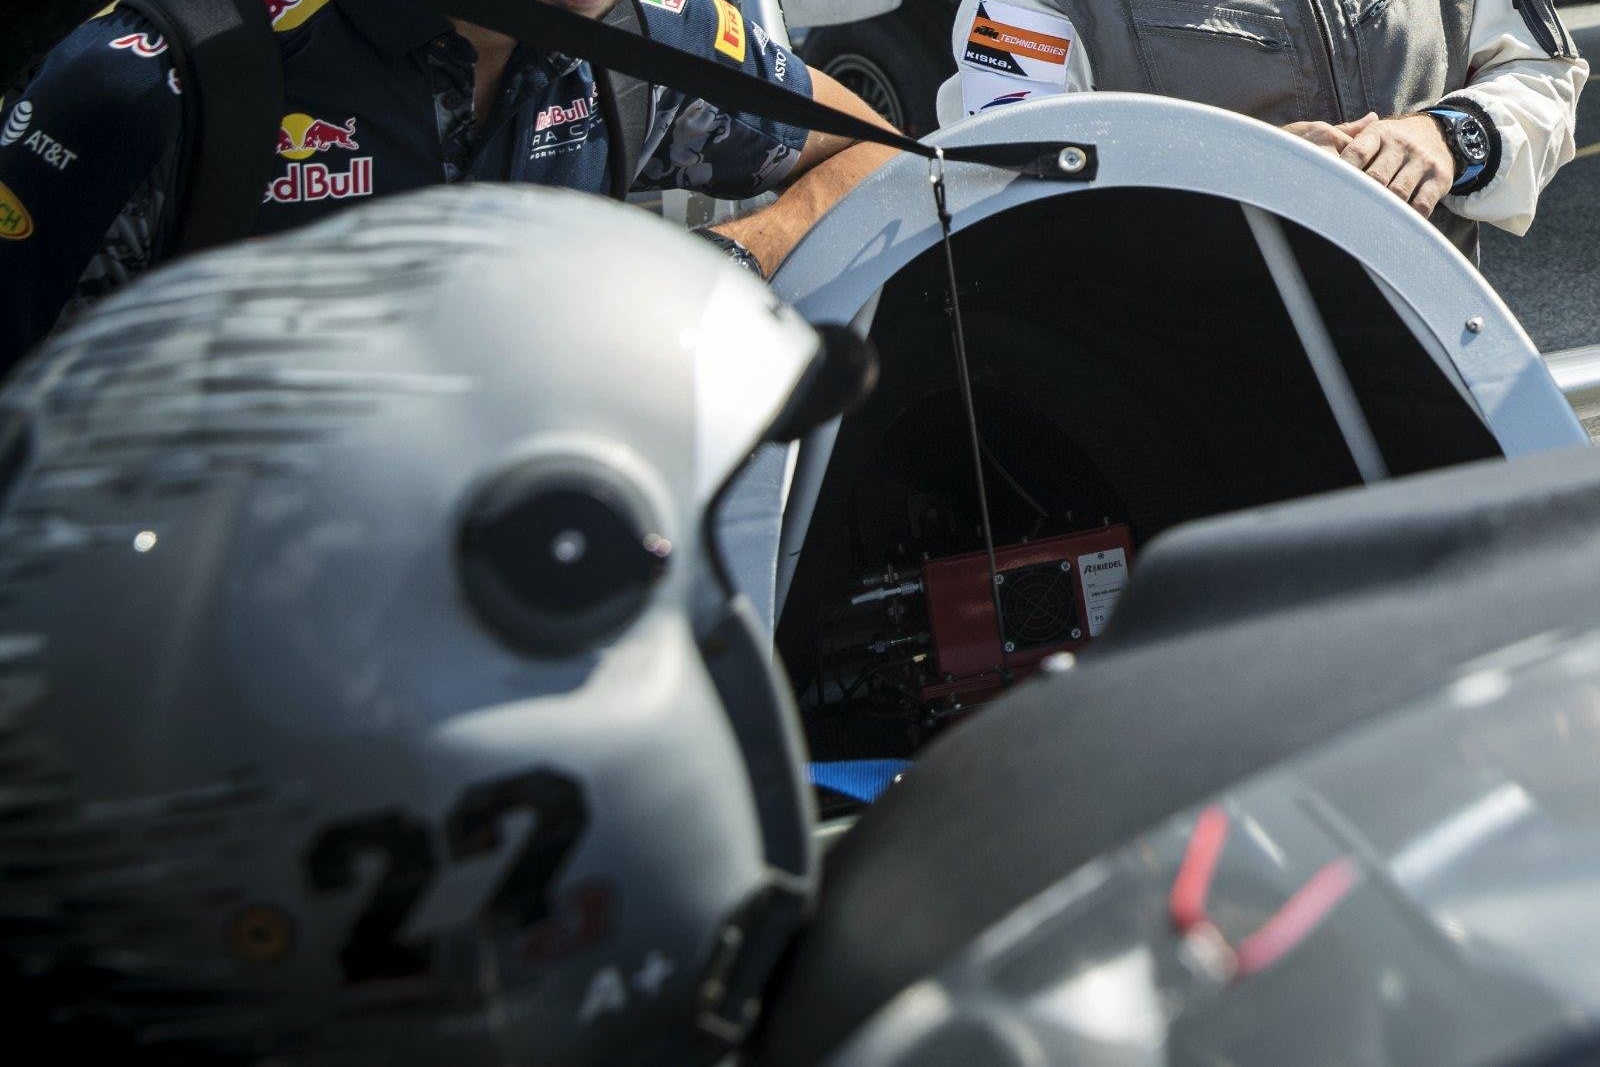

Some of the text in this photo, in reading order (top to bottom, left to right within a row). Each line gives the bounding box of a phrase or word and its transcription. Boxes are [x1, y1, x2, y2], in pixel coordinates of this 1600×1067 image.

[549, 98, 589, 126] Bull
[24, 130, 78, 170] AT&T
[304, 156, 373, 201] Bull
[308, 765, 592, 985] 22
